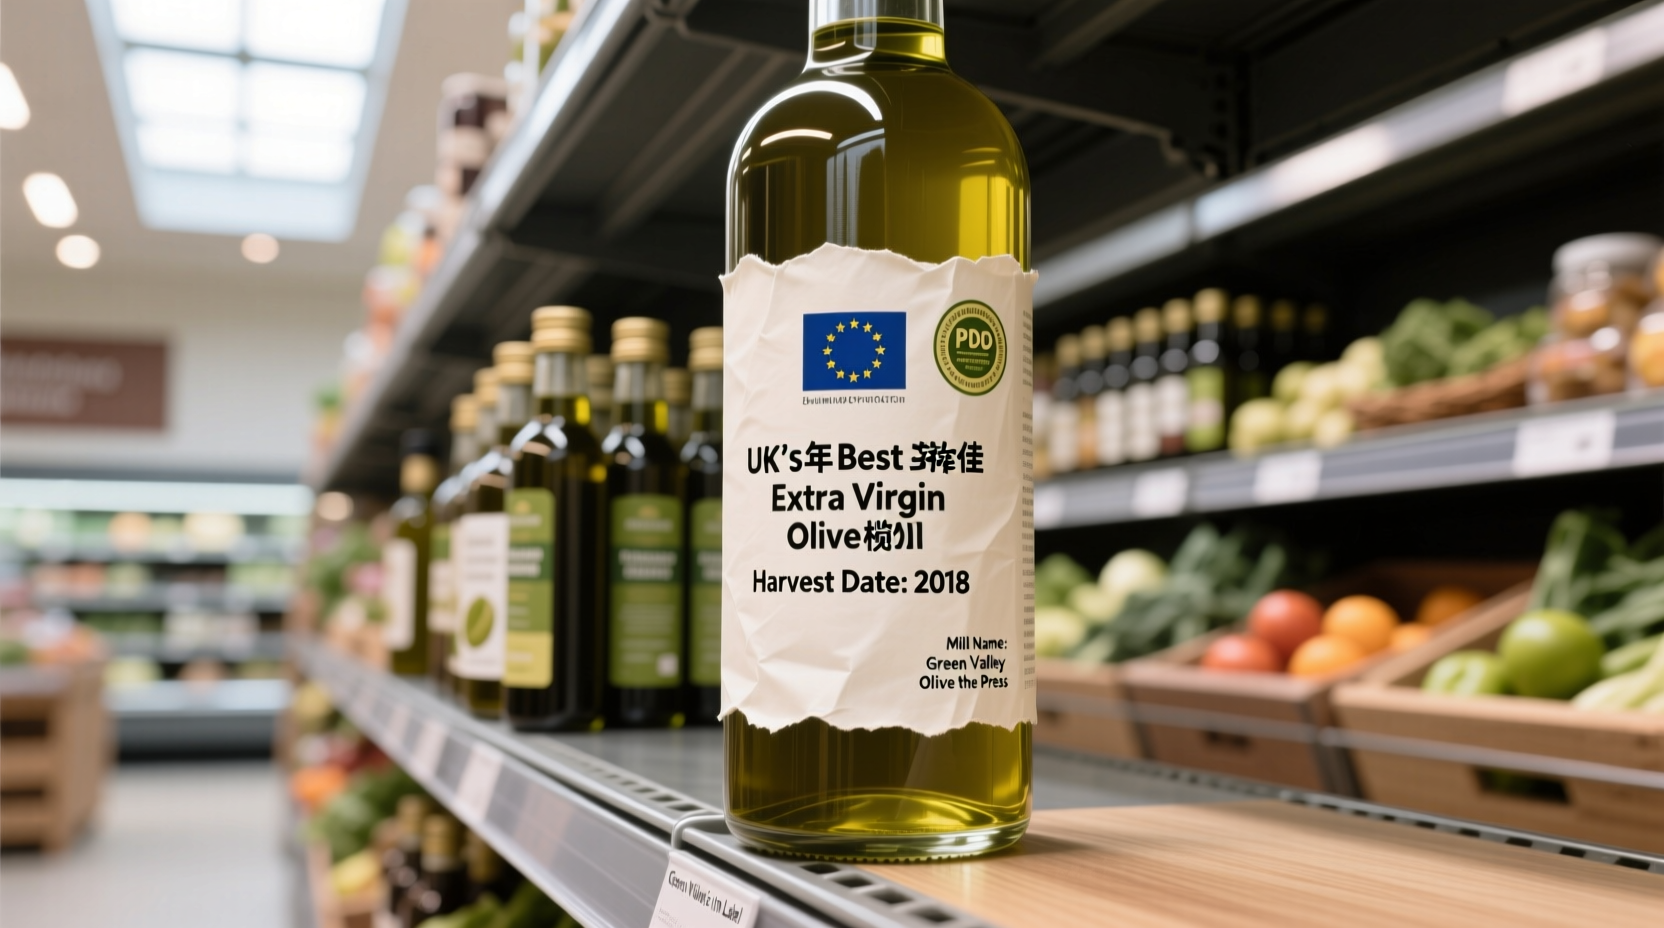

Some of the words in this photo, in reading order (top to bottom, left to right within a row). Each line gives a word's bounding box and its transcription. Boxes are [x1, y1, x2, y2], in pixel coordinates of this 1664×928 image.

[955, 326, 993, 351] PDO
[838, 443, 904, 471] Best
[772, 484, 845, 512] Extra
[852, 481, 945, 518] Virgin
[753, 570, 835, 594] Harvest
[842, 570, 908, 594] Date:
[914, 570, 970, 595] 2018
[946, 635, 970, 651] Mill
[972, 636, 1008, 651] Name:
[926, 656, 967, 671] Green
[969, 654, 1006, 673] Valley
[919, 675, 956, 690] Olive
[957, 675, 978, 690] the
[980, 675, 1009, 689] Press
